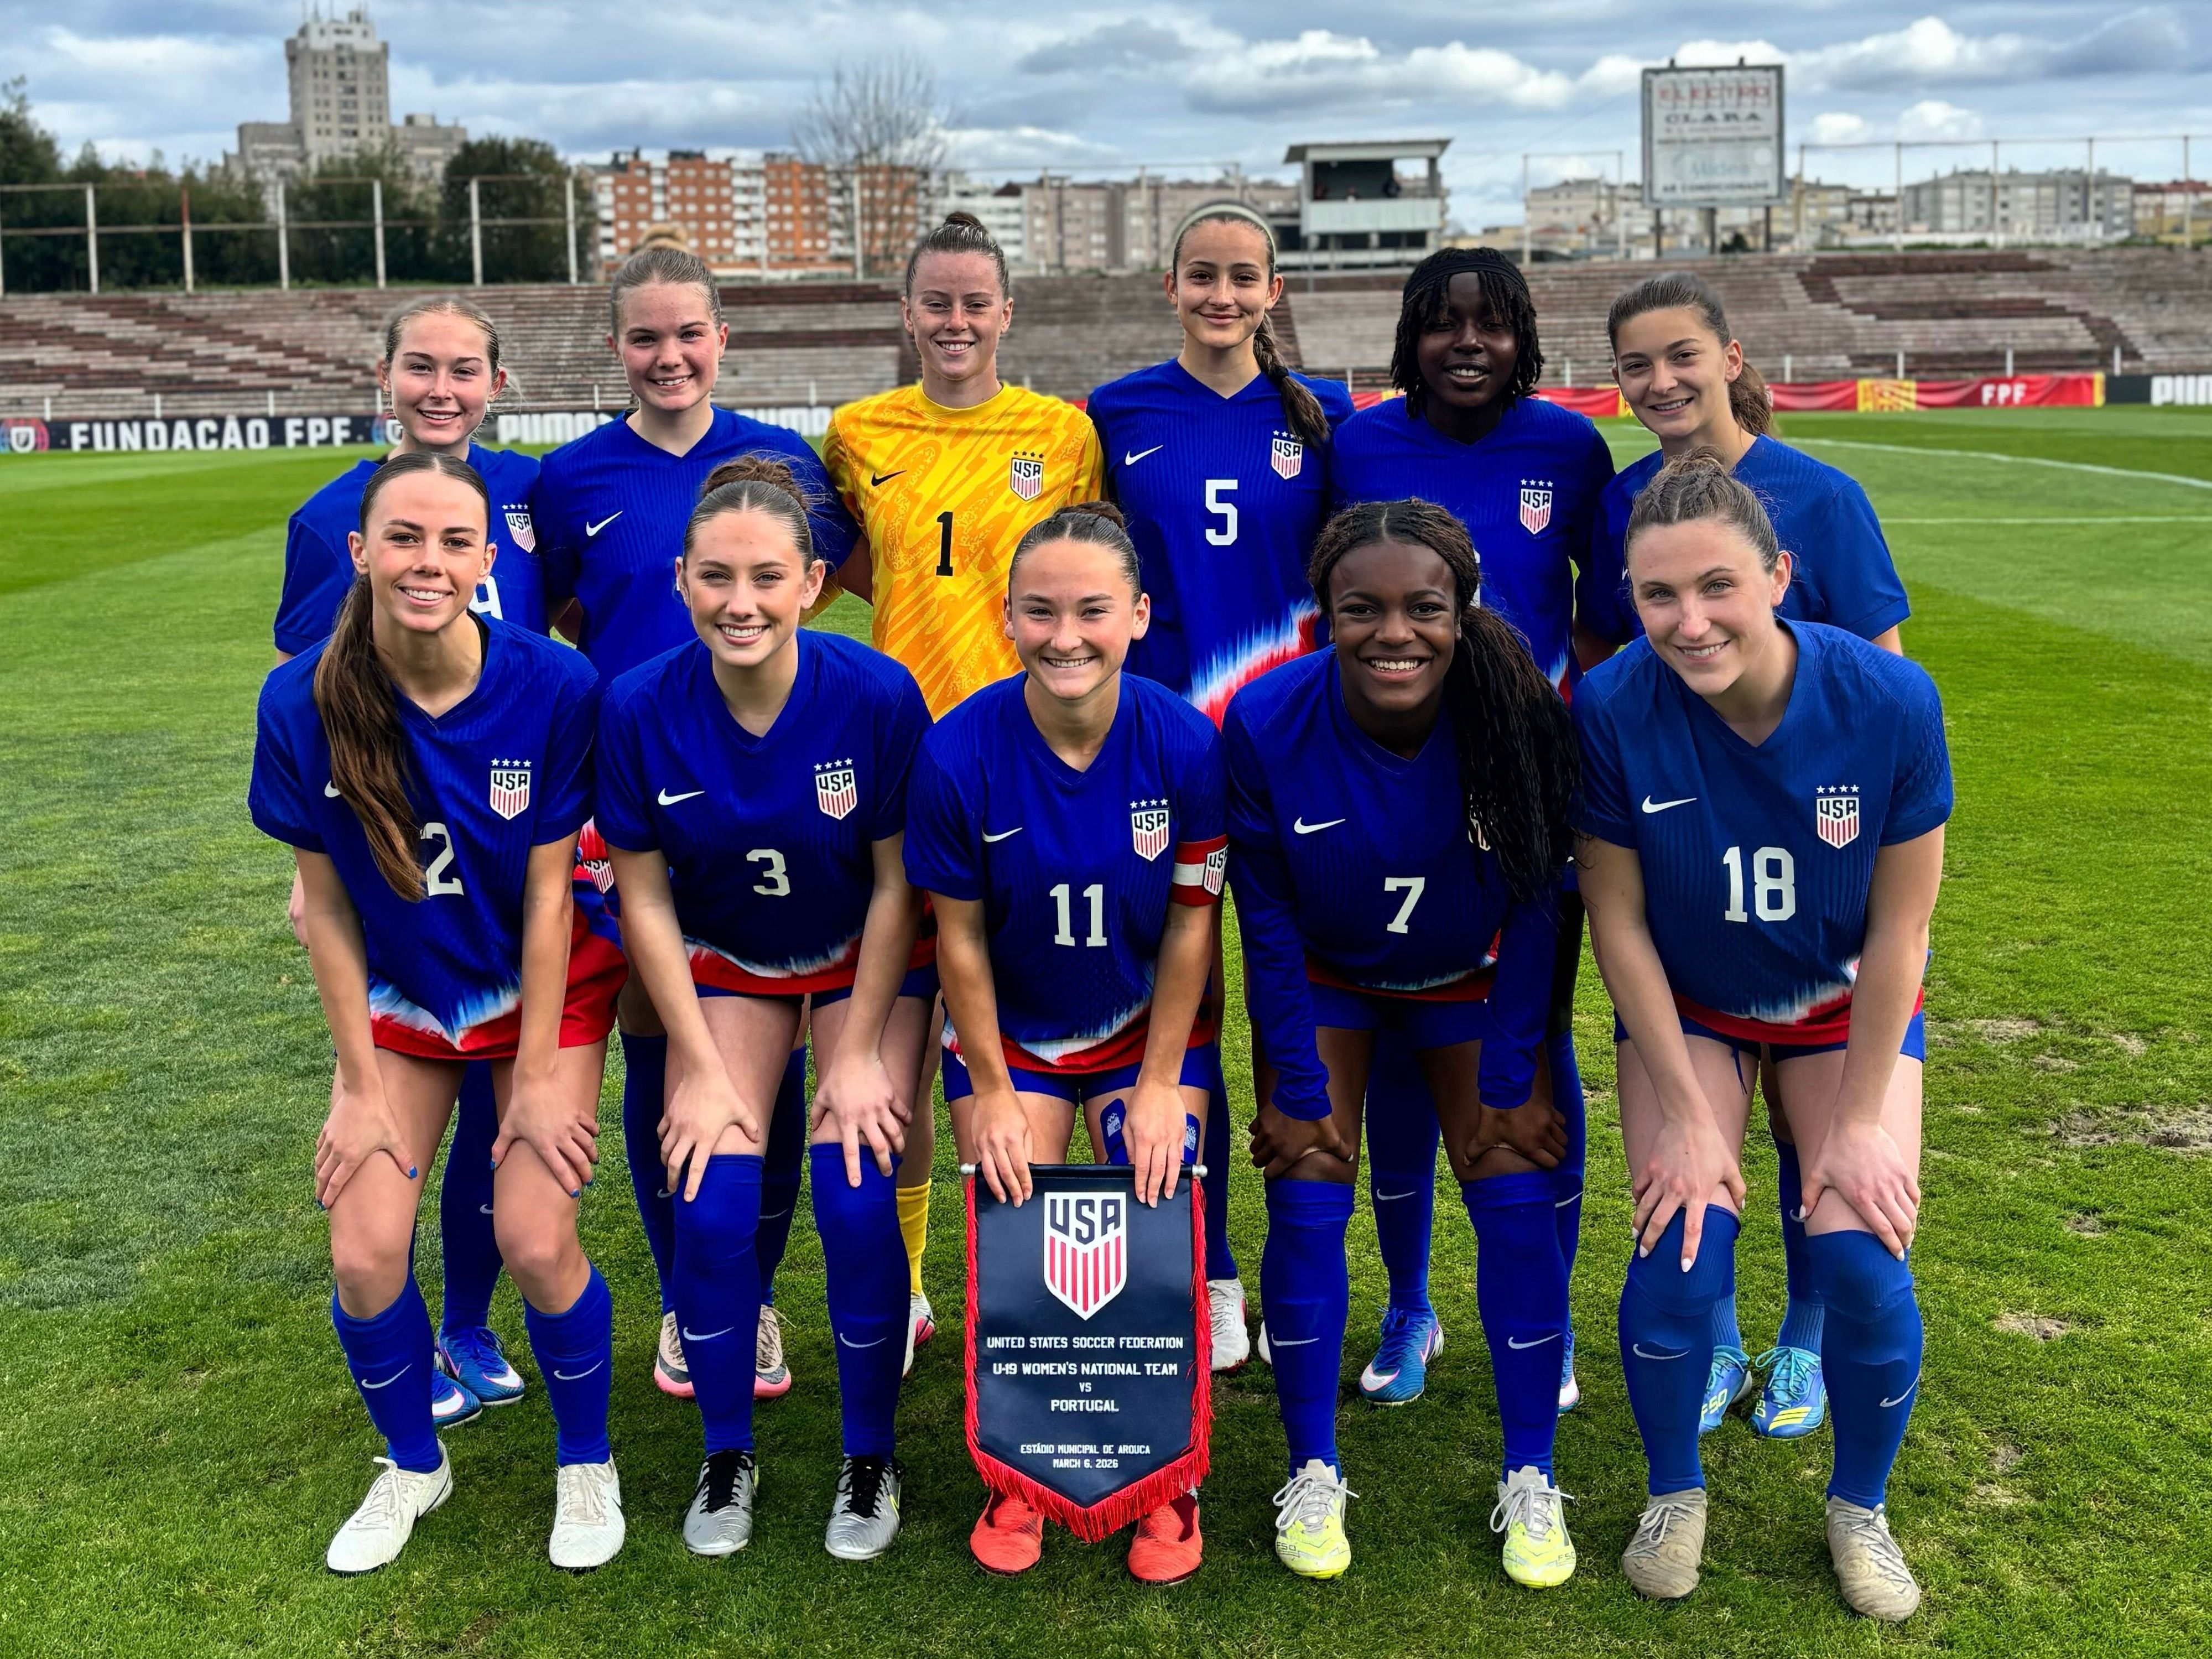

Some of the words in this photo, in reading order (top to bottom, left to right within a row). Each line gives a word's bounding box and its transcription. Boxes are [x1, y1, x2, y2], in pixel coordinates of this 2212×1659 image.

[1982, 383, 2027, 406] FPF
[285, 417, 351, 448] FPF
[1274, 440, 1300, 457] USA
[1014, 461, 1040, 478] USA
[1522, 491, 1550, 508] USA
[1205, 479, 1238, 545] 5
[507, 515, 530, 531] USA
[936, 511, 953, 576] 1
[493, 772, 528, 791] USA
[819, 772, 852, 792] USA
[1819, 800, 1857, 819] USA
[1133, 812, 1167, 831] USA
[420, 822, 464, 896] 2
[746, 849, 790, 896] 3
[1723, 846, 1795, 922] 18
[1384, 877, 1425, 934] 7
[1049, 884, 1107, 947] 11
[1050, 1199, 1121, 1245] USA
[987, 1336, 1025, 1349] UNITED
[1029, 1336, 1068, 1349] STATES
[1073, 1336, 1115, 1349] SOCCER
[1120, 1336, 1183, 1349] FEDERATION
[993, 1362, 1018, 1375] U-19
[1022, 1361, 1078, 1375] WOMEN'S
[1081, 1362, 1141, 1375] NATIONAL
[1144, 1362, 1178, 1375] TEAM
[1079, 1382, 1092, 1392] VS
[1050, 1399, 1120, 1412] PORTUGAL
[1021, 1443, 1054, 1454] ESTÁDIO
[1058, 1444, 1099, 1454] MUNICIPAL
[1103, 1444, 1115, 1454] DE
[1118, 1444, 1151, 1454] AROUCA
[1053, 1459, 1080, 1469] MARCH
[1095, 1459, 1118, 1469] 2026
